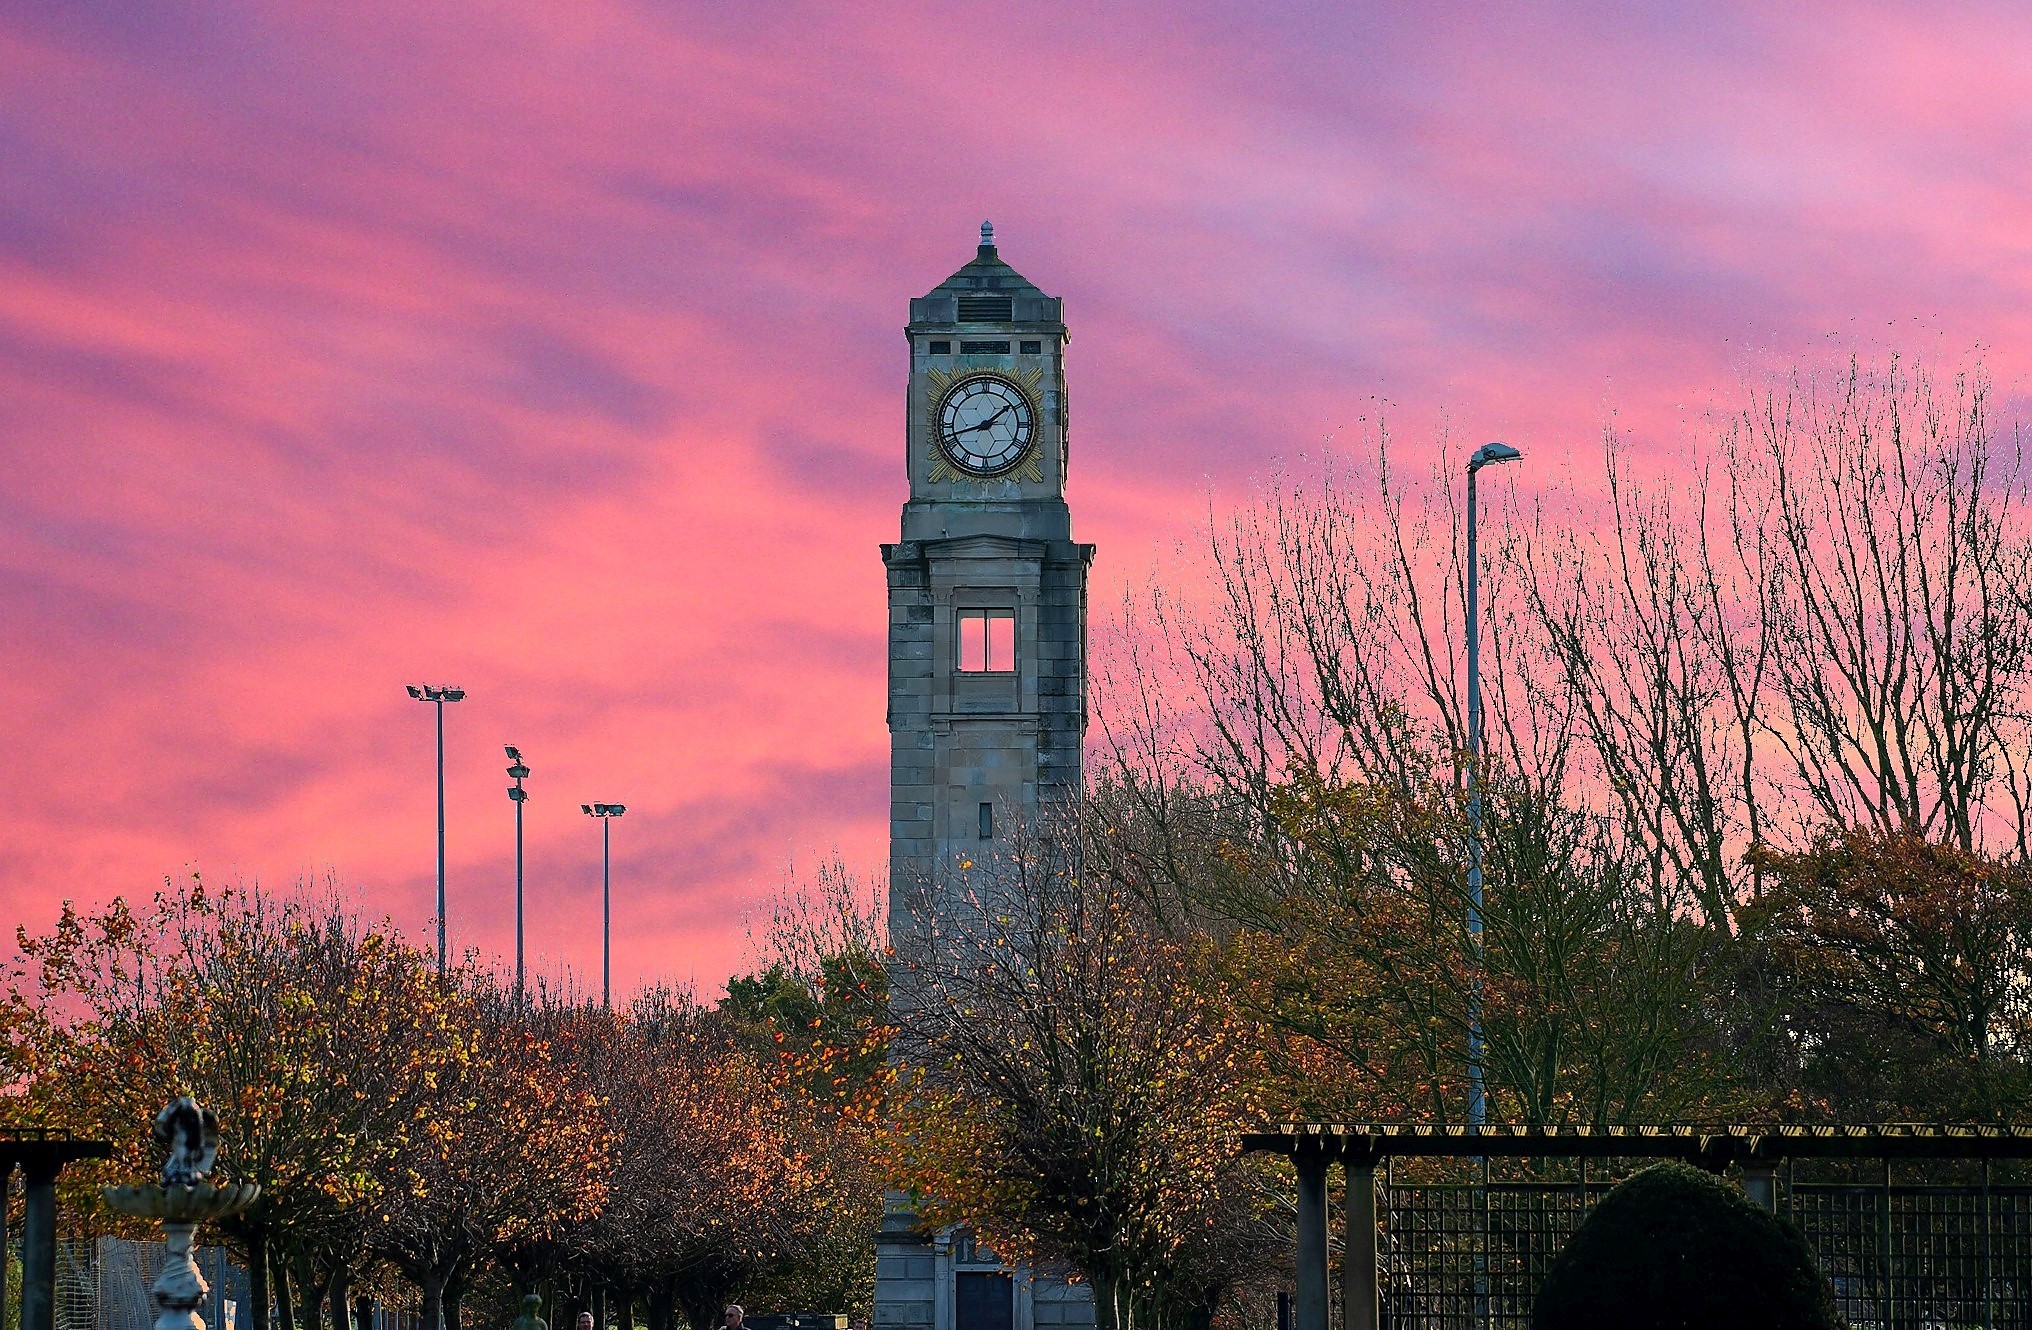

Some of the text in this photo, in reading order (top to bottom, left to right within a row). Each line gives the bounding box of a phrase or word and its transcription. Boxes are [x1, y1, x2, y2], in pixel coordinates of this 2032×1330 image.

[963, 386, 972, 397] XI
[947, 401, 957, 411] X
[1013, 402, 1024, 410] II
[1013, 438, 1024, 449] IIII
[962, 452, 971, 463] VII
[983, 457, 989, 467] VI
